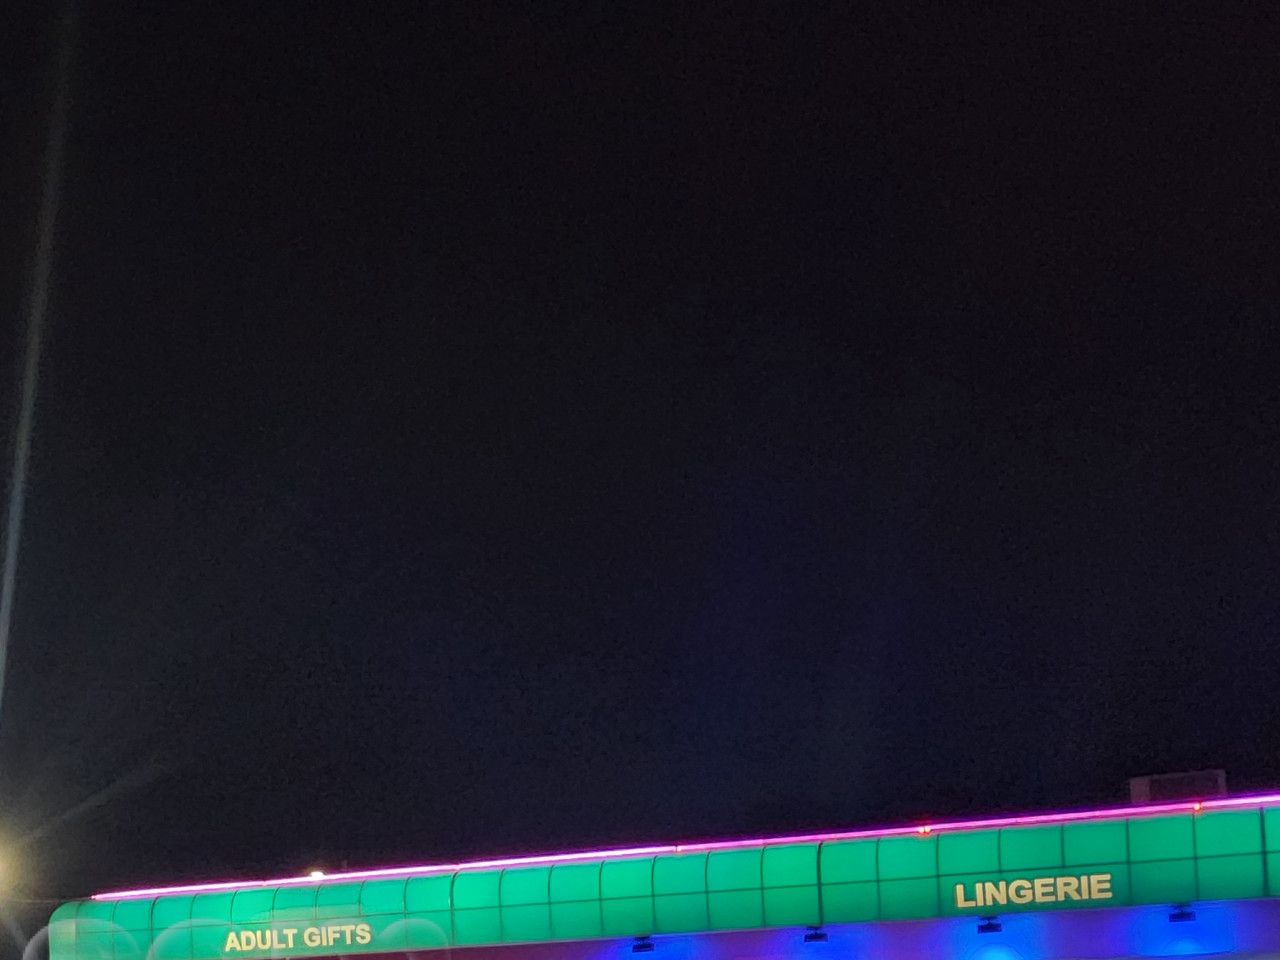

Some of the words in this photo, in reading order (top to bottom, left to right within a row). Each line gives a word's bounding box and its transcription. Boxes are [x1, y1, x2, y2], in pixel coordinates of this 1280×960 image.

[955, 873, 1113, 908] LINGERIE
[225, 928, 297, 952] ADULT
[303, 924, 371, 947] GIFTS
